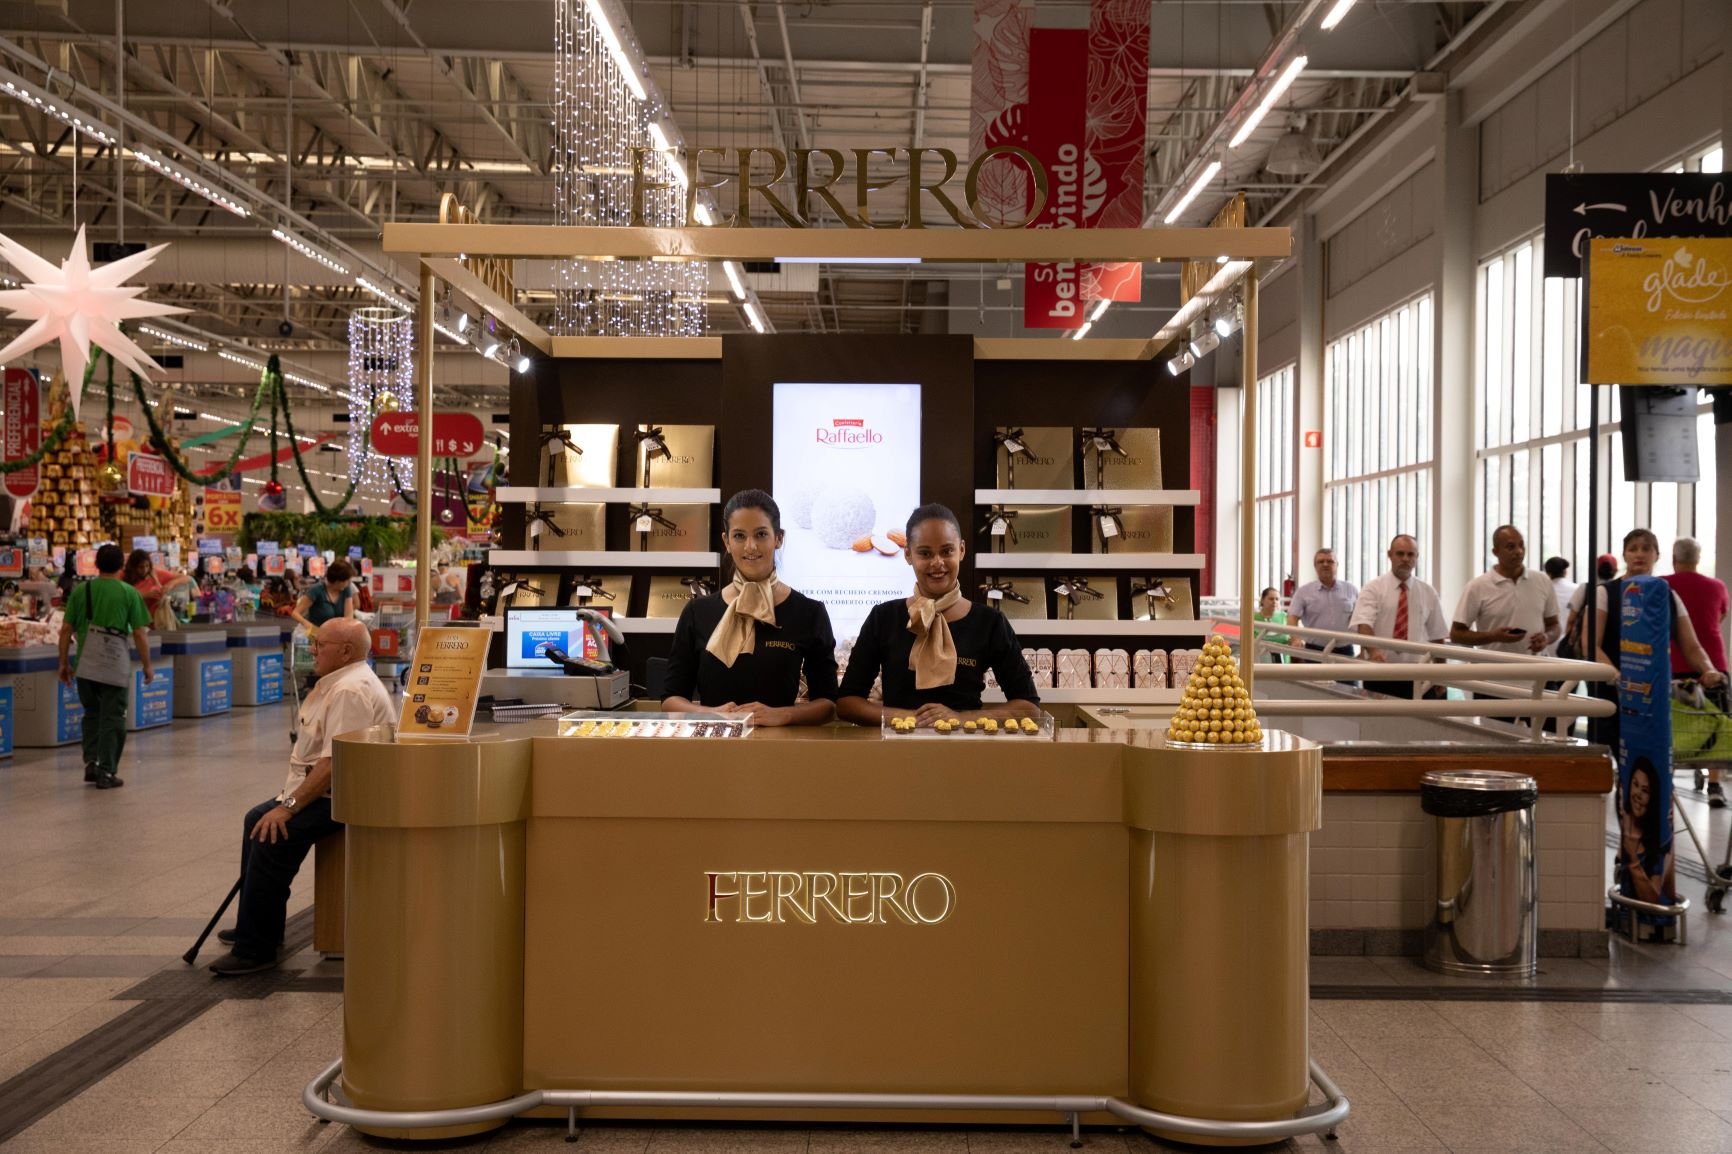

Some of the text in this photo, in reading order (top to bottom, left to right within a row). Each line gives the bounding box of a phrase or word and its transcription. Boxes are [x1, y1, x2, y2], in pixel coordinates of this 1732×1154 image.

[627, 146, 1049, 229] FERRERO
[1643, 257, 1730, 313] glade
[7, 380, 21, 456] PREFERENCIAL
[393, 424, 419, 433] extra
[816, 428, 883, 443] Raffaello
[208, 506, 239, 526] 6x
[436, 641, 469, 650] FERRERO
[765, 640, 796, 651] FERRERO
[703, 871, 957, 925] FERRERO
